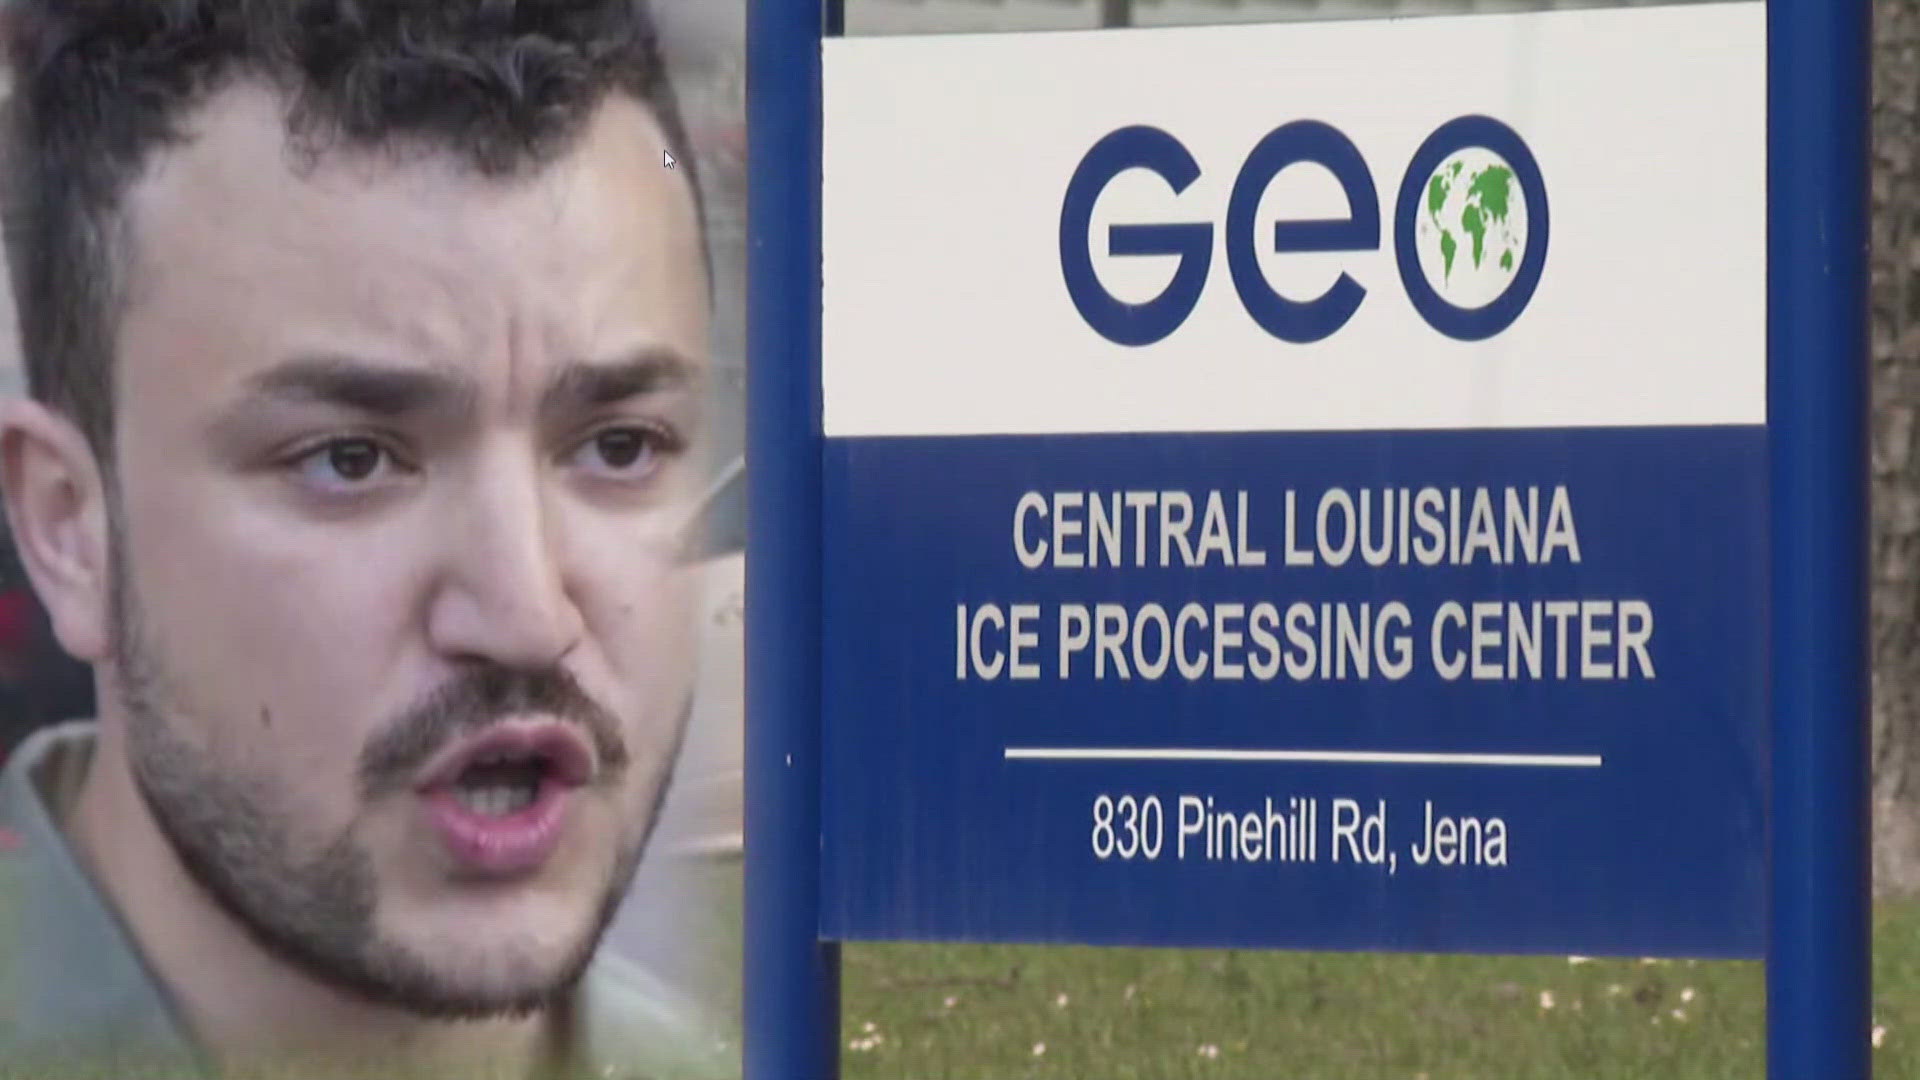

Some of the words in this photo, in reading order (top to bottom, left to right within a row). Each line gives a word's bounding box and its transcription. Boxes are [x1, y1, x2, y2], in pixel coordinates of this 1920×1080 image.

[1013, 490, 1266, 569] CENTRAL
[1285, 486, 1581, 567] LOUISIANA
[956, 603, 1041, 680] ICE
[1059, 601, 1413, 681] PROCESSING
[1431, 600, 1655, 680] CENTER
[1092, 794, 1163, 860] 830
[1178, 795, 1317, 862] Pinehill
[1332, 798, 1397, 874] Rd,
[1411, 800, 1507, 866] Jena
